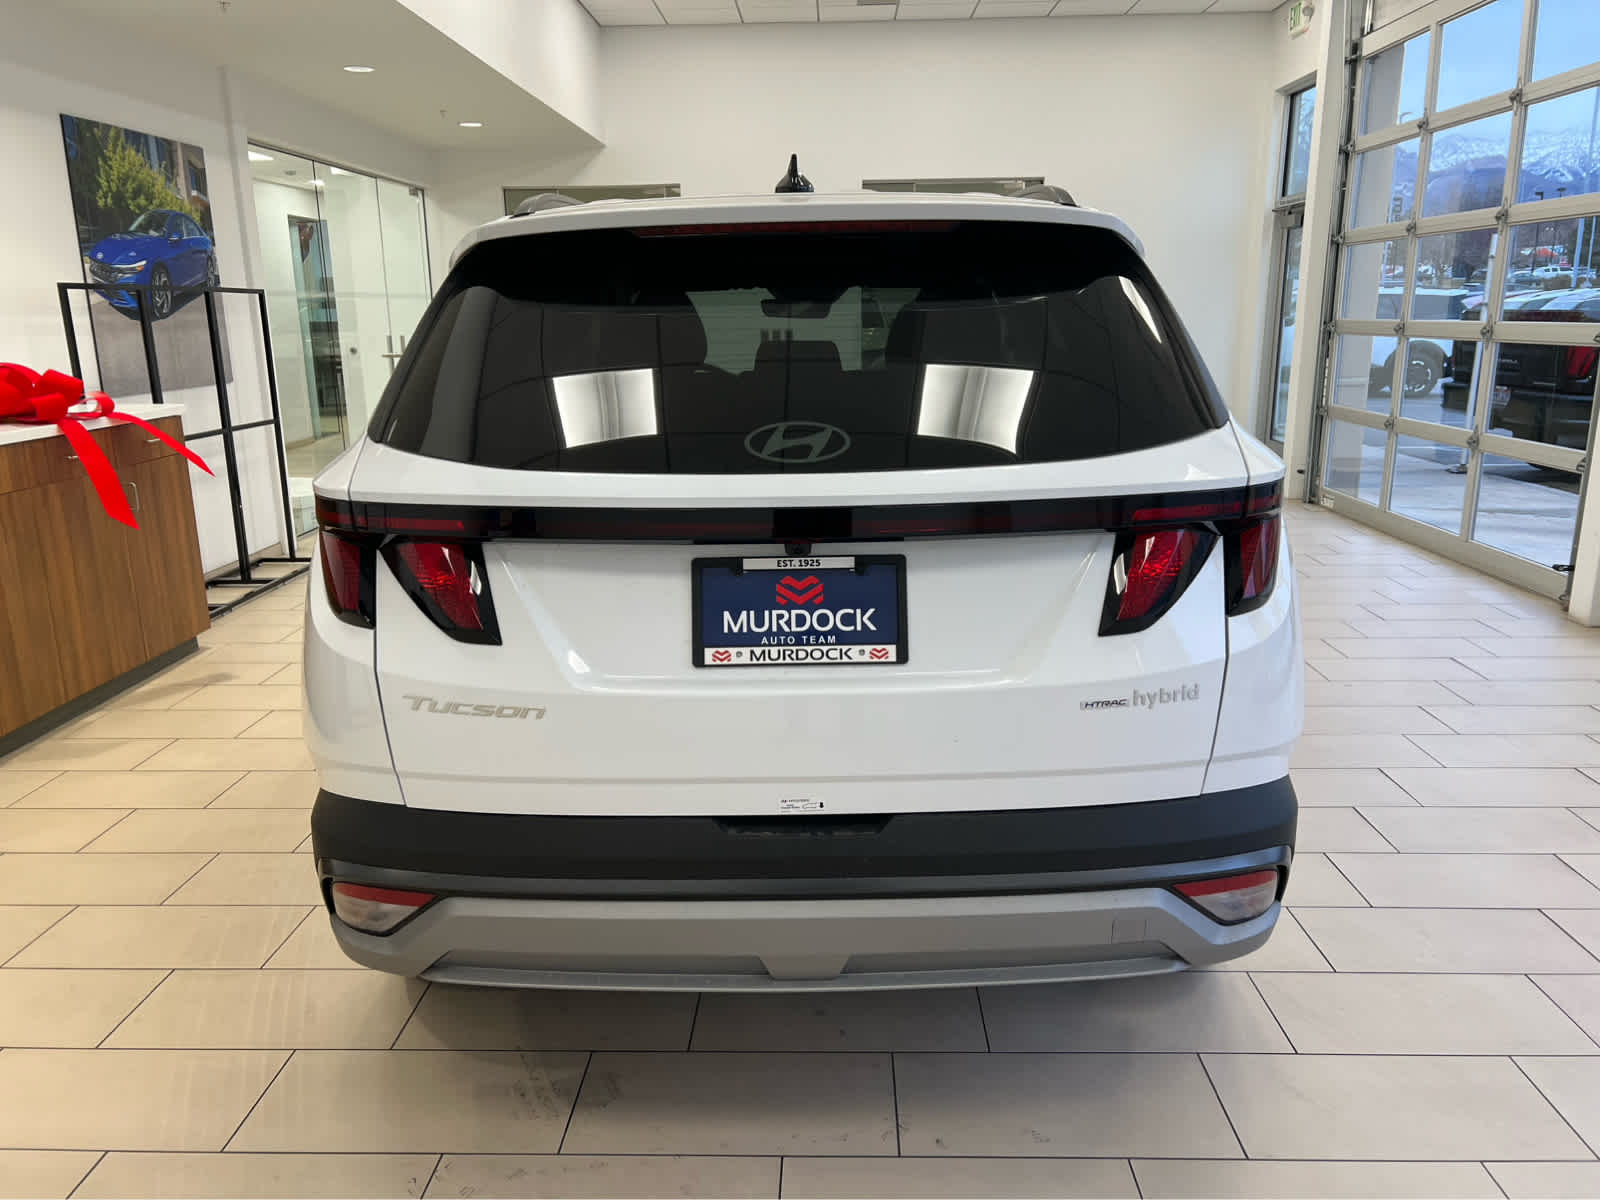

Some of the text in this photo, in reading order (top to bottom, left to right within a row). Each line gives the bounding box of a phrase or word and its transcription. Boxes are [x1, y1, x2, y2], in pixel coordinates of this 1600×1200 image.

[777, 559, 821, 567] EST. 1925
[723, 608, 877, 633] MURDOCK
[761, 635, 836, 645] AUTO TEAM
[750, 648, 852, 662] MURDOCK
[1084, 683, 1199, 709] HTRAC hybrid
